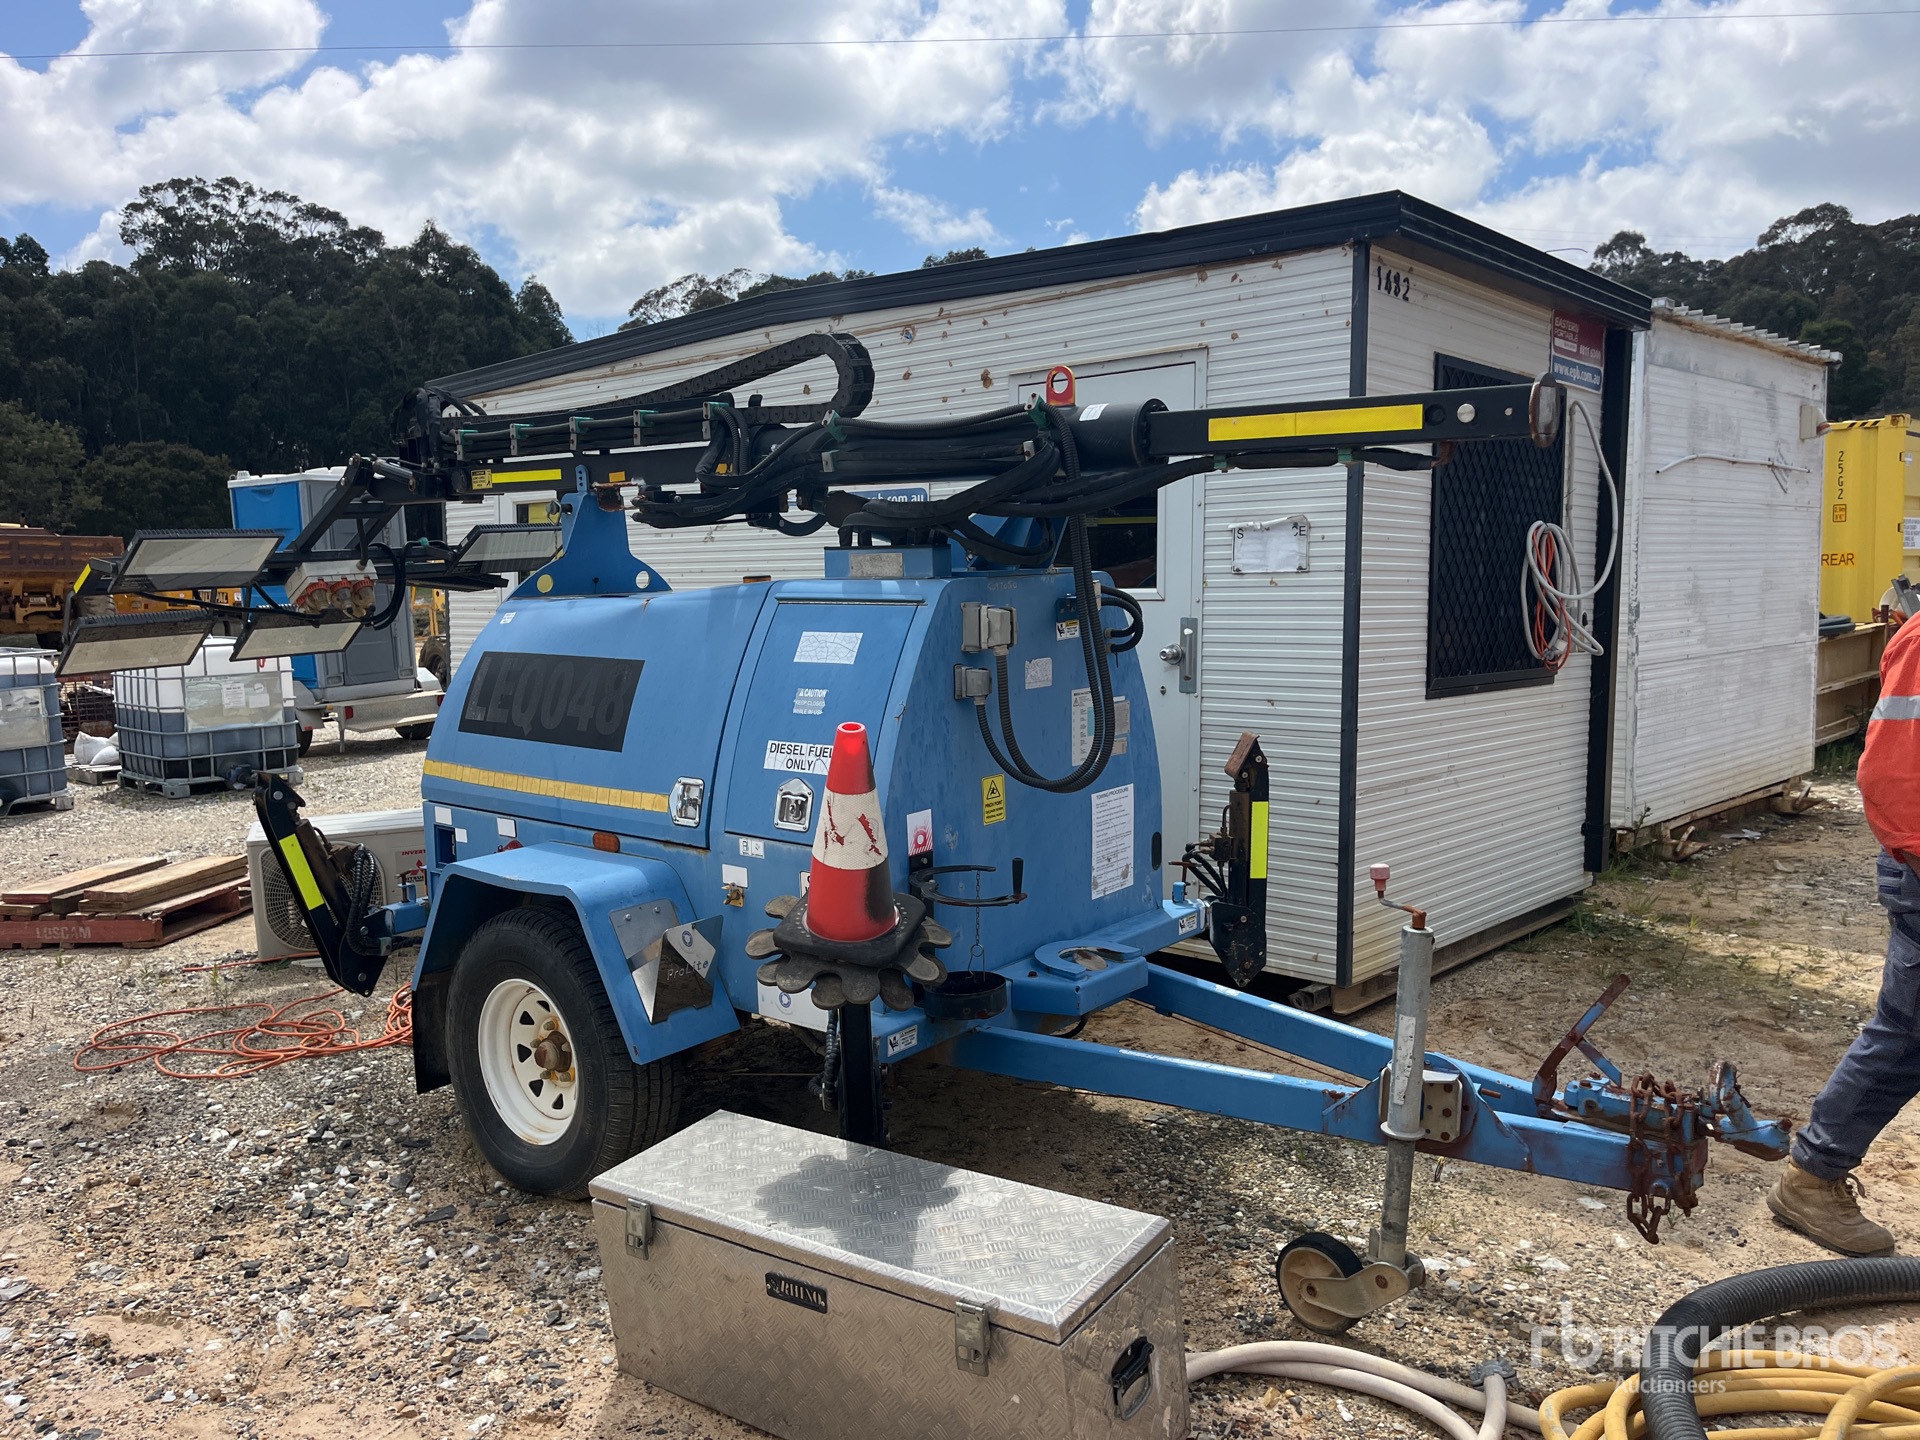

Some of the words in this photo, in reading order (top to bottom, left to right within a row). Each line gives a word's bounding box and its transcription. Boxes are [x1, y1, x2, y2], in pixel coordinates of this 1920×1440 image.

[1821, 553, 1855, 566] REAR
[465, 655, 633, 736] LEQ048
[804, 688, 827, 697] CAUTION
[769, 742, 805, 756] DIESEL
[786, 758, 814, 771] ONLY
[35, 926, 92, 940] LOSCAM
[780, 1280, 822, 1305] RHINO
